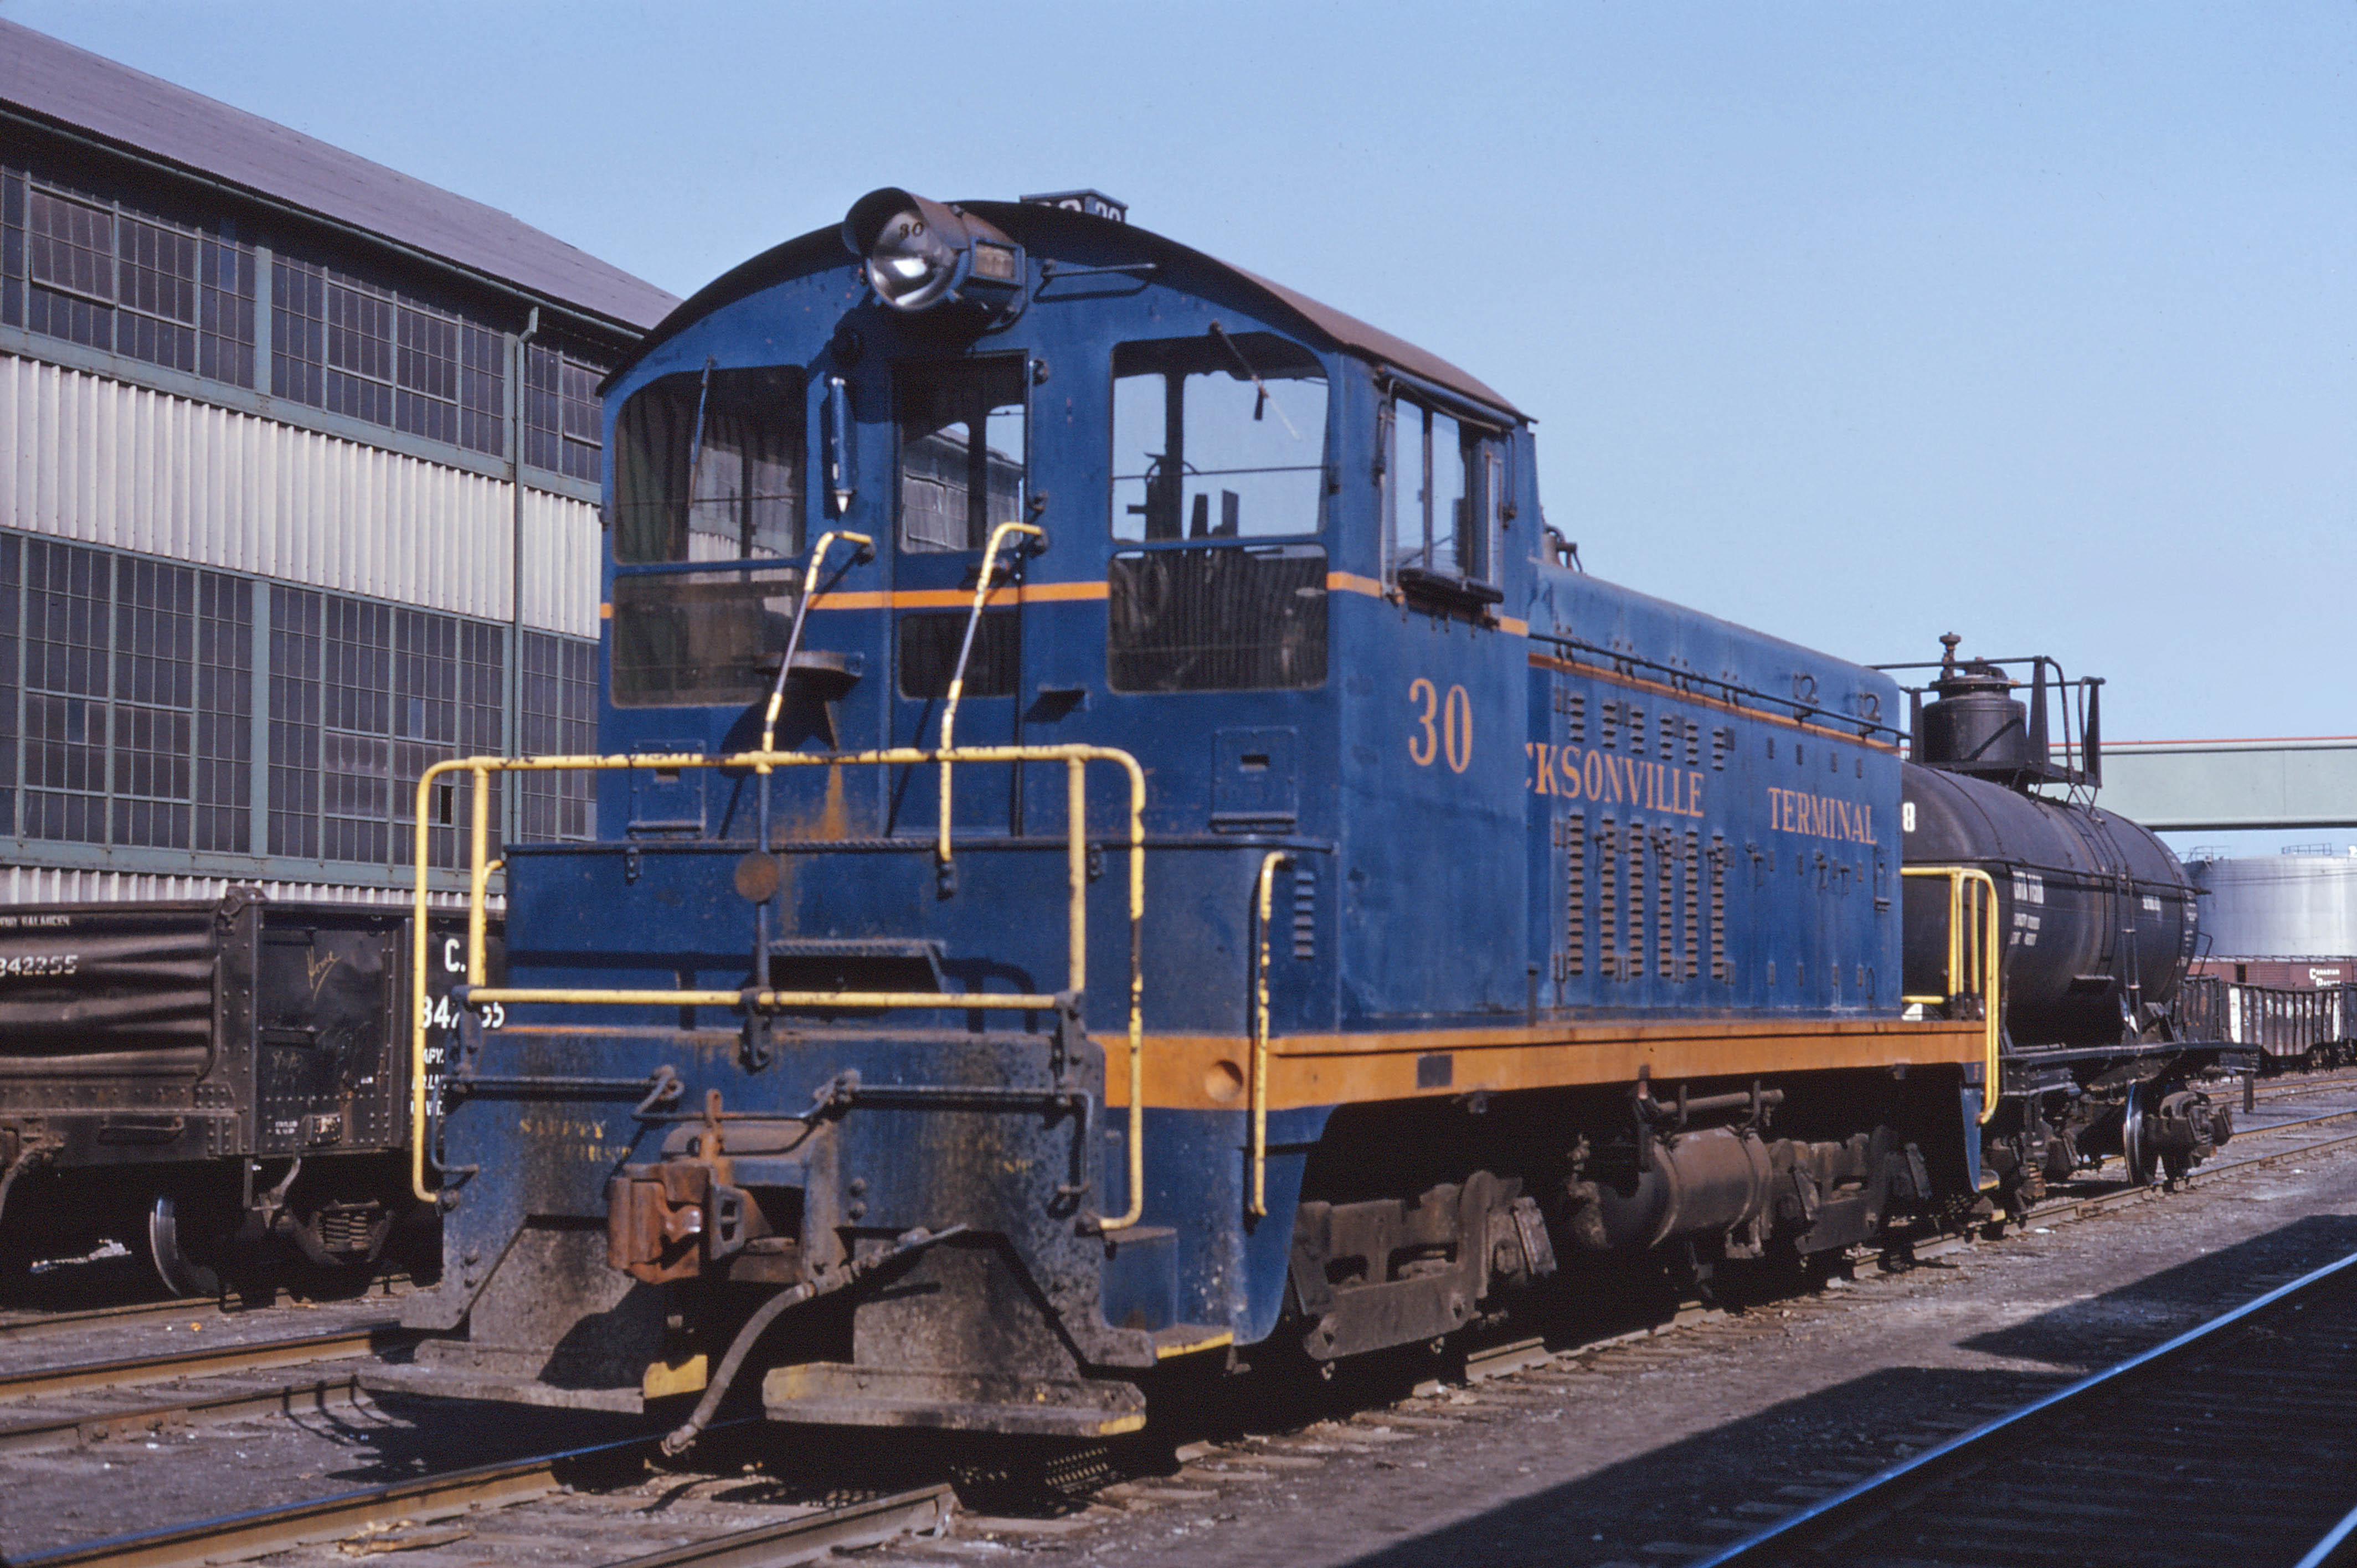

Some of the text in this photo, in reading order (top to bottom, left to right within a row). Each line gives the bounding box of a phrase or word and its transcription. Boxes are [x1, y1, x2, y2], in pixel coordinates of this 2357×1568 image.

[899, 221, 924, 239] 30
[1409, 678, 1473, 773] 30
[1768, 787, 1877, 844] TERMINAL
